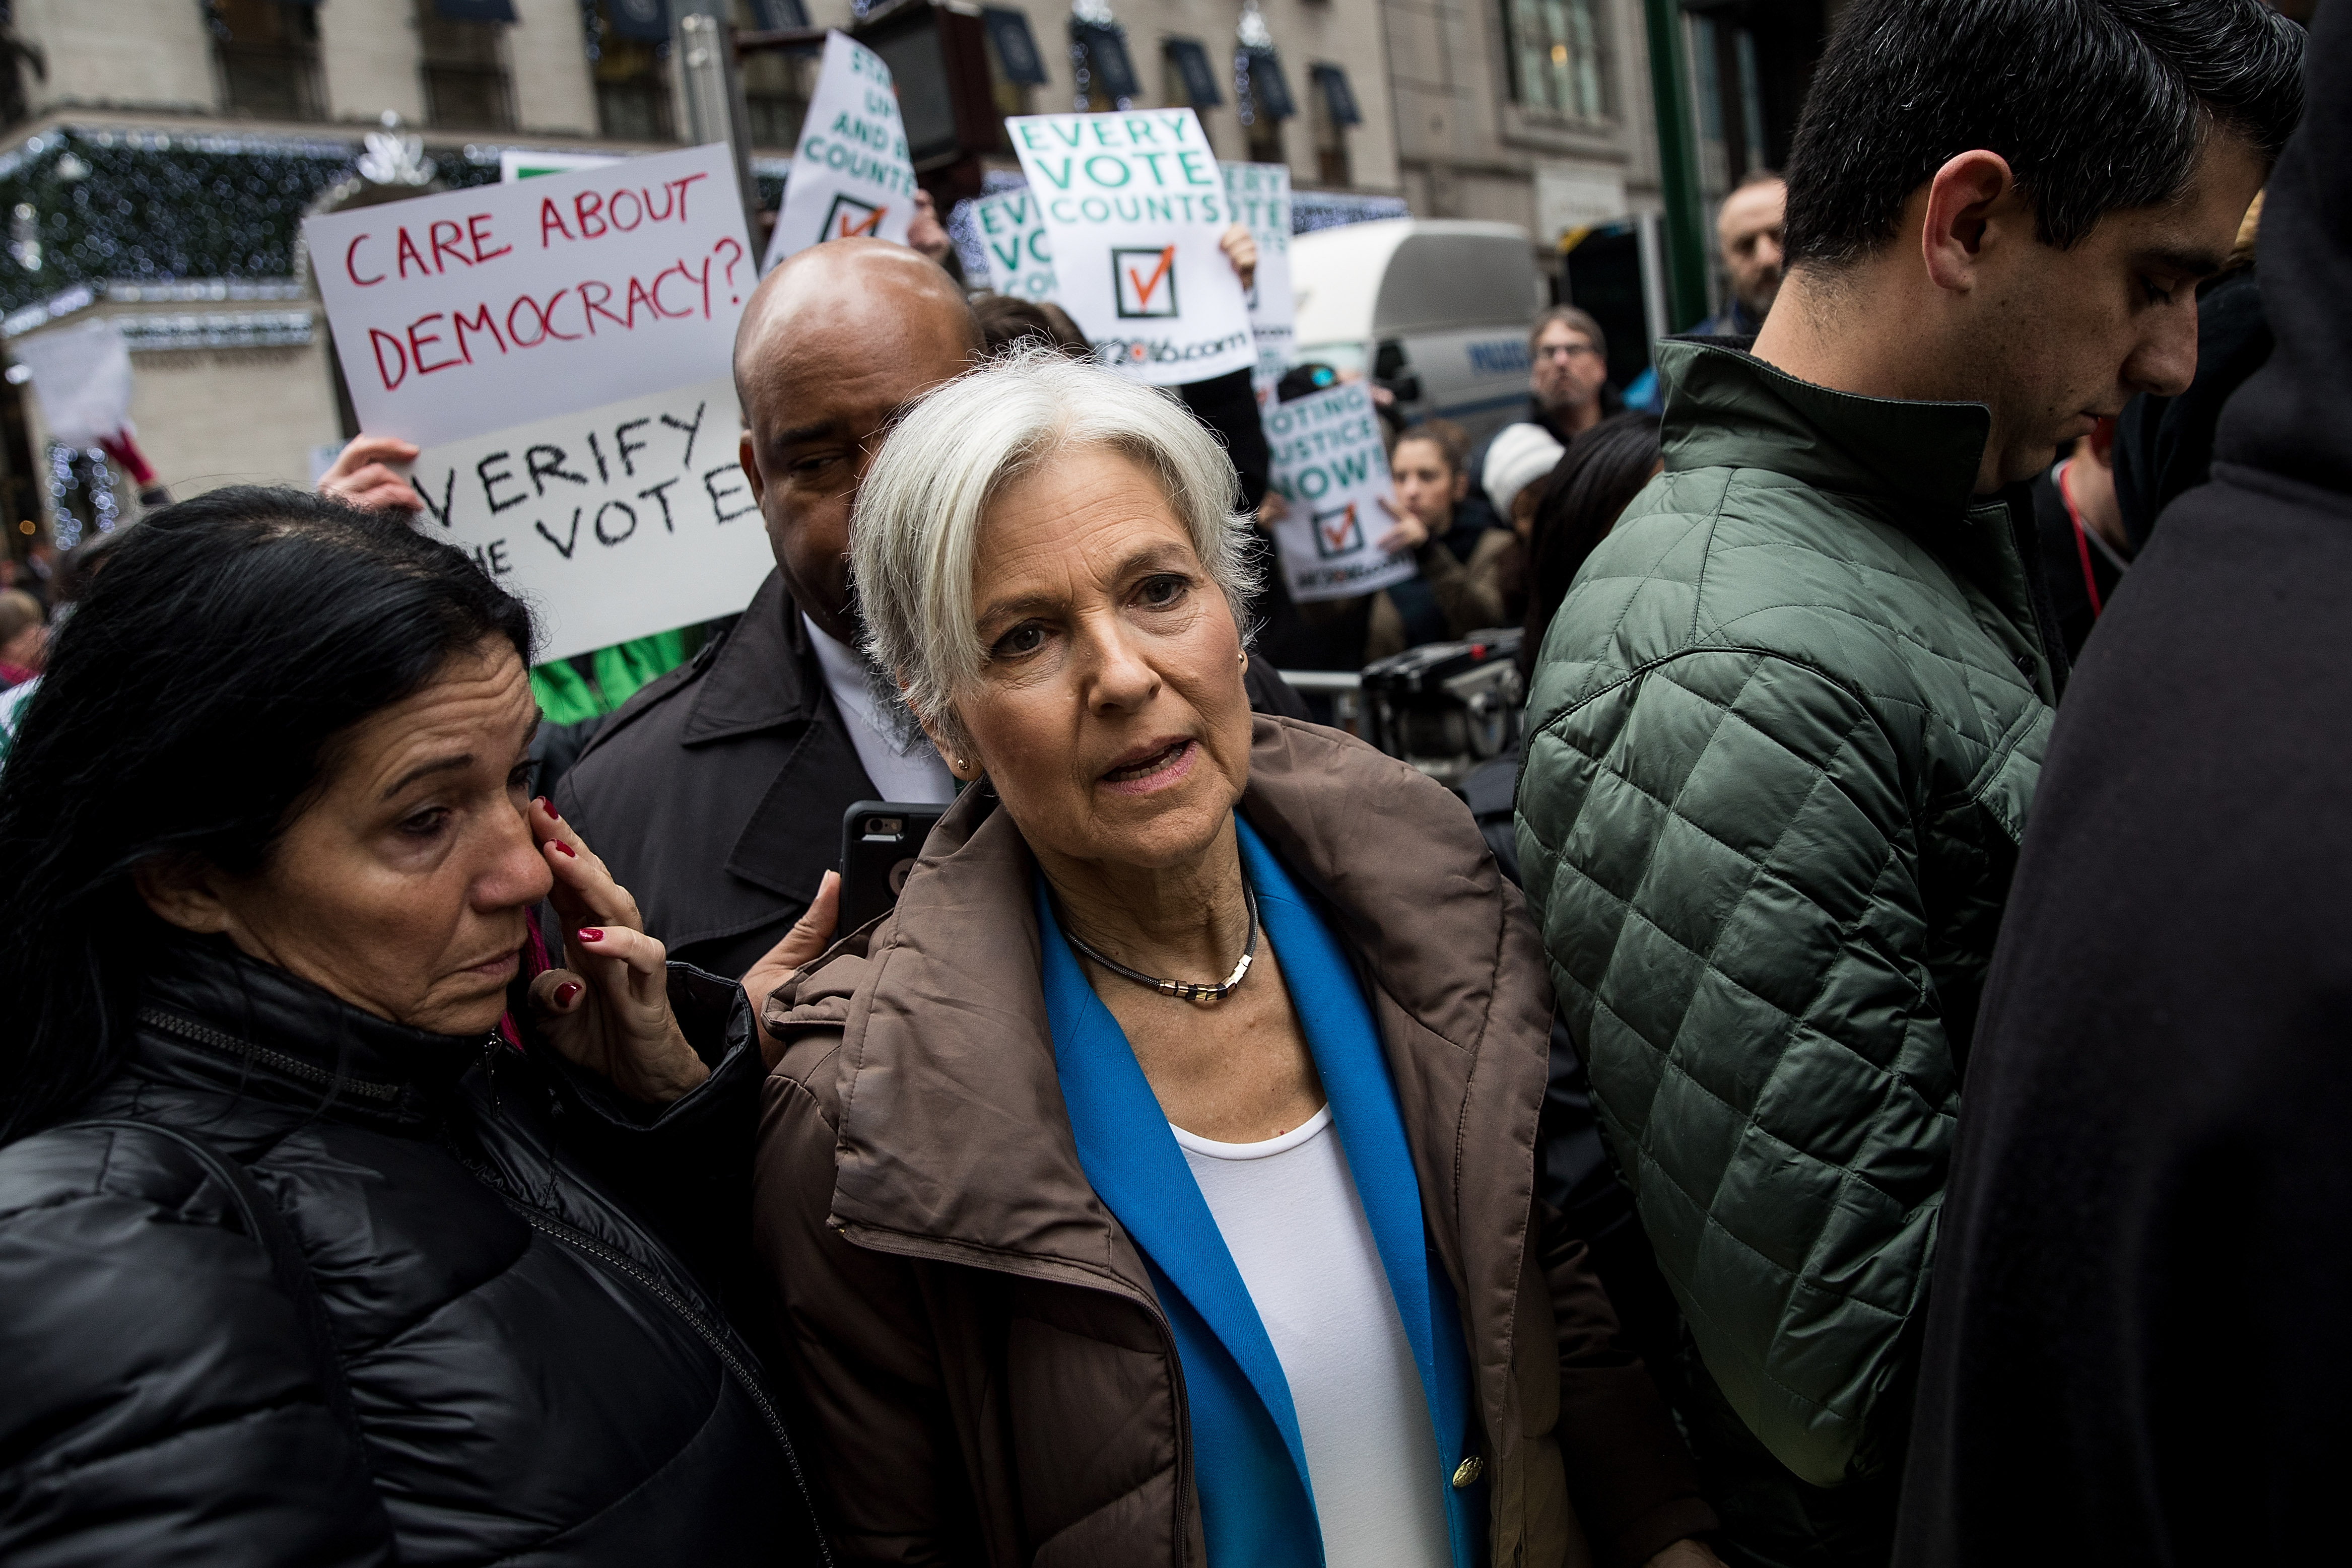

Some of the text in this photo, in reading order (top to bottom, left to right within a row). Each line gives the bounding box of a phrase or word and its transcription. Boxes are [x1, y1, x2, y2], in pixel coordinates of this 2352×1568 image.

[832, 111, 890, 150] AND
[1018, 115, 1187, 150] EVERY
[1034, 151, 1214, 190] VOTE
[346, 173, 708, 287] CARE ABOUT
[1051, 195, 1219, 223] COUNTS
[369, 236, 743, 390] DEMOCRACY?
[1271, 388, 1365, 435] OTING
[1269, 417, 1372, 465] USTICE
[411, 402, 705, 528] VERIFY
[535, 463, 759, 559] VOTE
